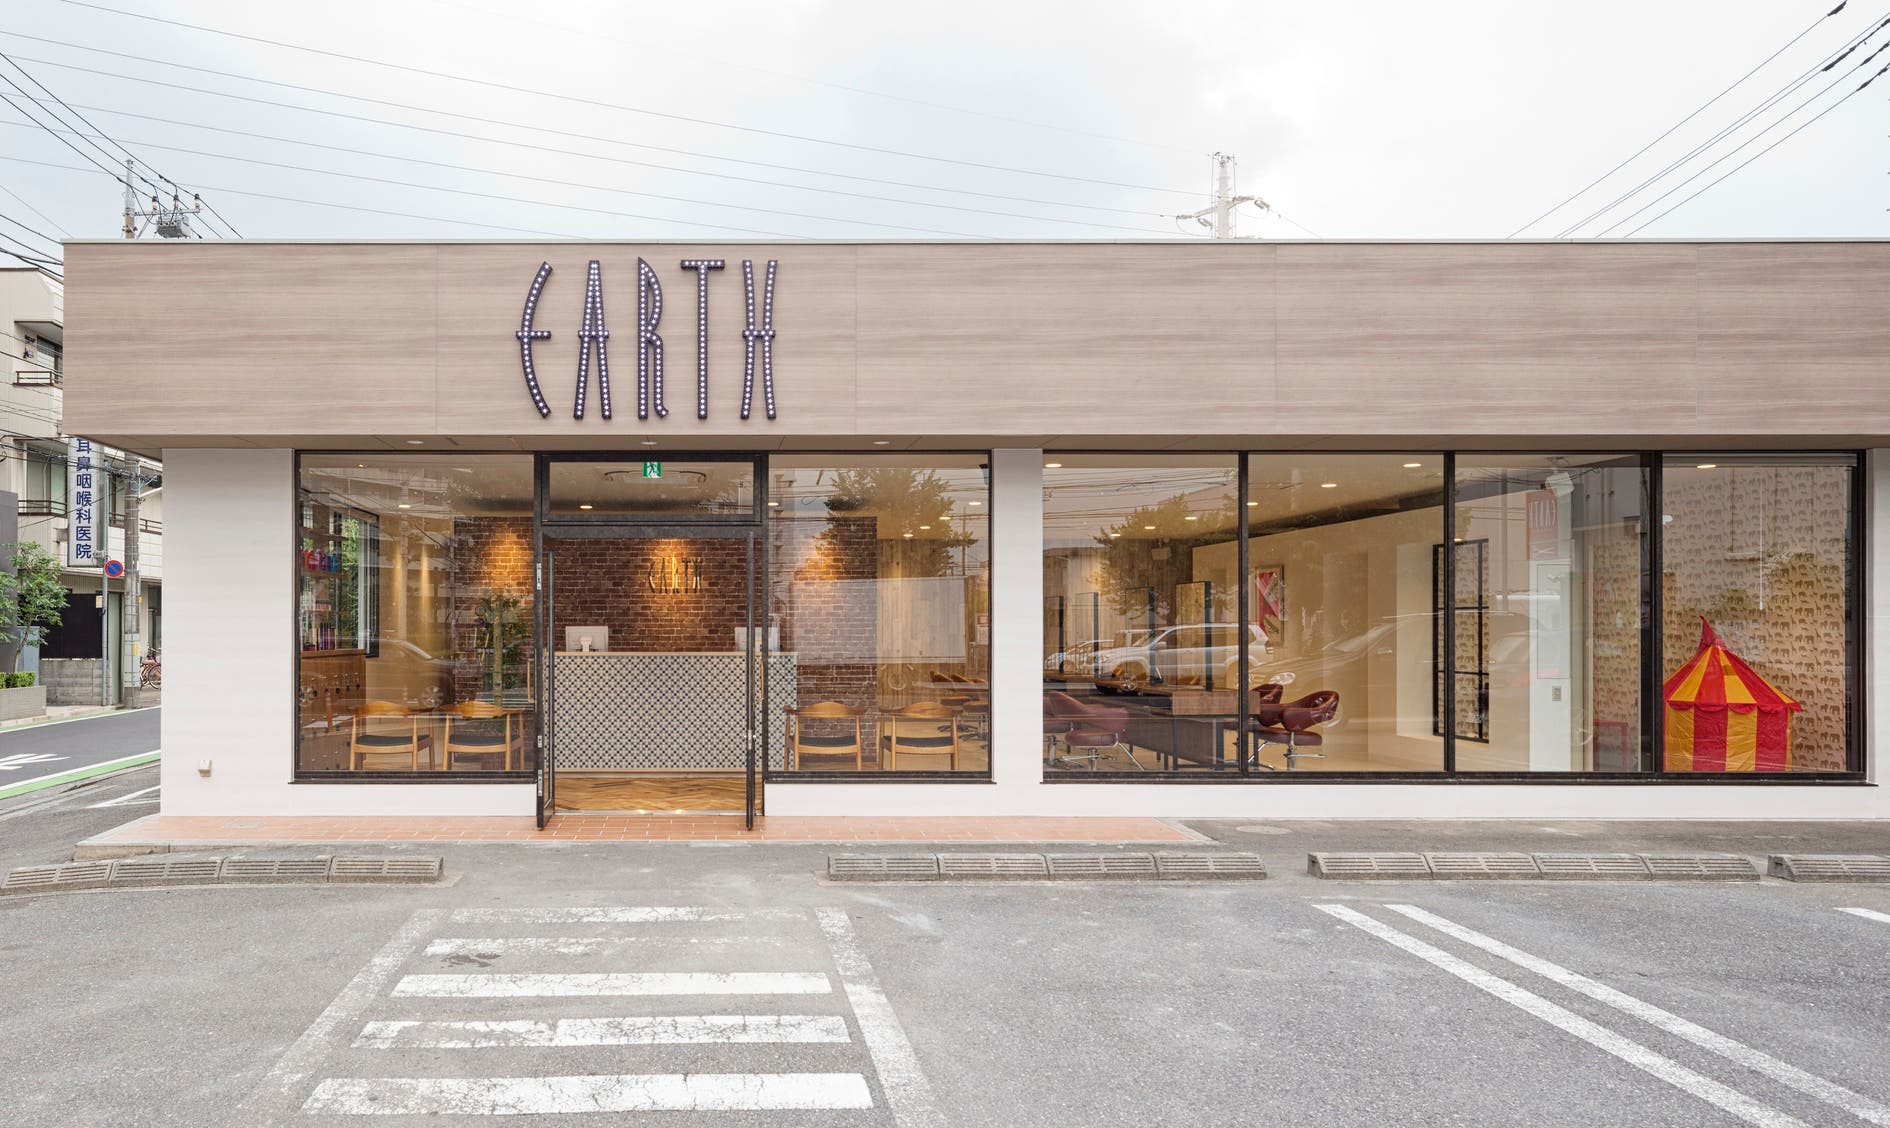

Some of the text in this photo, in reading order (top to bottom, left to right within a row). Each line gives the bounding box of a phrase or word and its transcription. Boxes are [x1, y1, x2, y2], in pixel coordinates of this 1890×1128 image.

[515, 256, 778, 420] EARTH
[75, 438, 92, 559] 耳鼻咽喉科医院
